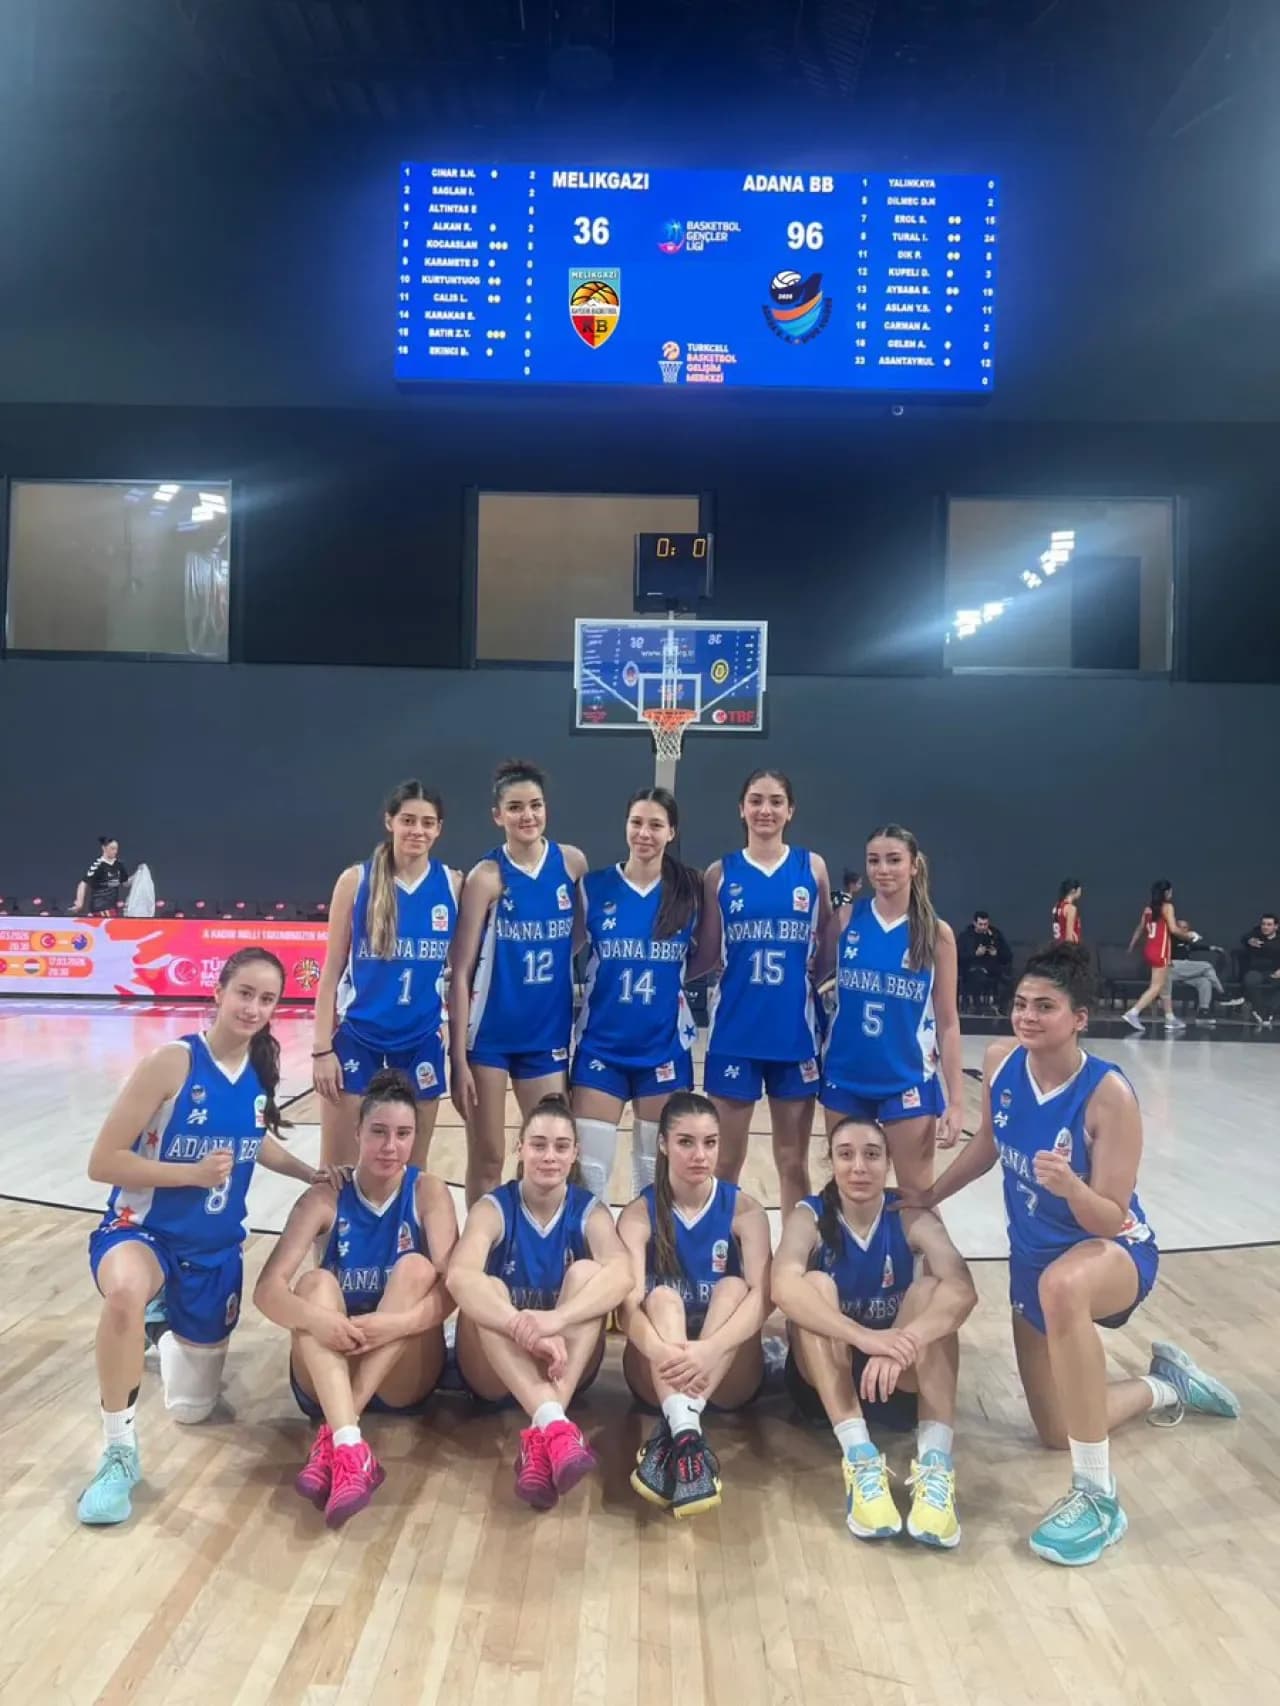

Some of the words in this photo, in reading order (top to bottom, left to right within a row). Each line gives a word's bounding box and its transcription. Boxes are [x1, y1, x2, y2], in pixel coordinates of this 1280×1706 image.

[552, 170, 650, 190] MELIKGAZI
[742, 174, 804, 192] ADANA
[809, 175, 834, 193] BB
[574, 216, 610, 245] 36
[686, 221, 741, 232] BASKETBOL
[787, 221, 824, 250] 96
[892, 232, 921, 242] TURAL
[858, 250, 868, 258] 11
[400, 274, 411, 284] 10
[399, 292, 409, 301] 11
[399, 310, 409, 319] 14
[856, 303, 867, 311] 14
[884, 303, 915, 312] ASLAN
[982, 306, 992, 314] 11
[692, 538, 706, 558] 0
[357, 936, 416, 960] ANA
[522, 948, 554, 984] 12
[748, 948, 786, 986] 15
[397, 968, 414, 1006] 1
[618, 966, 656, 1006] 14
[884, 973, 926, 1002] BBSK
[862, 1000, 886, 1038] 5
[1016, 1180, 1040, 1218] 7
